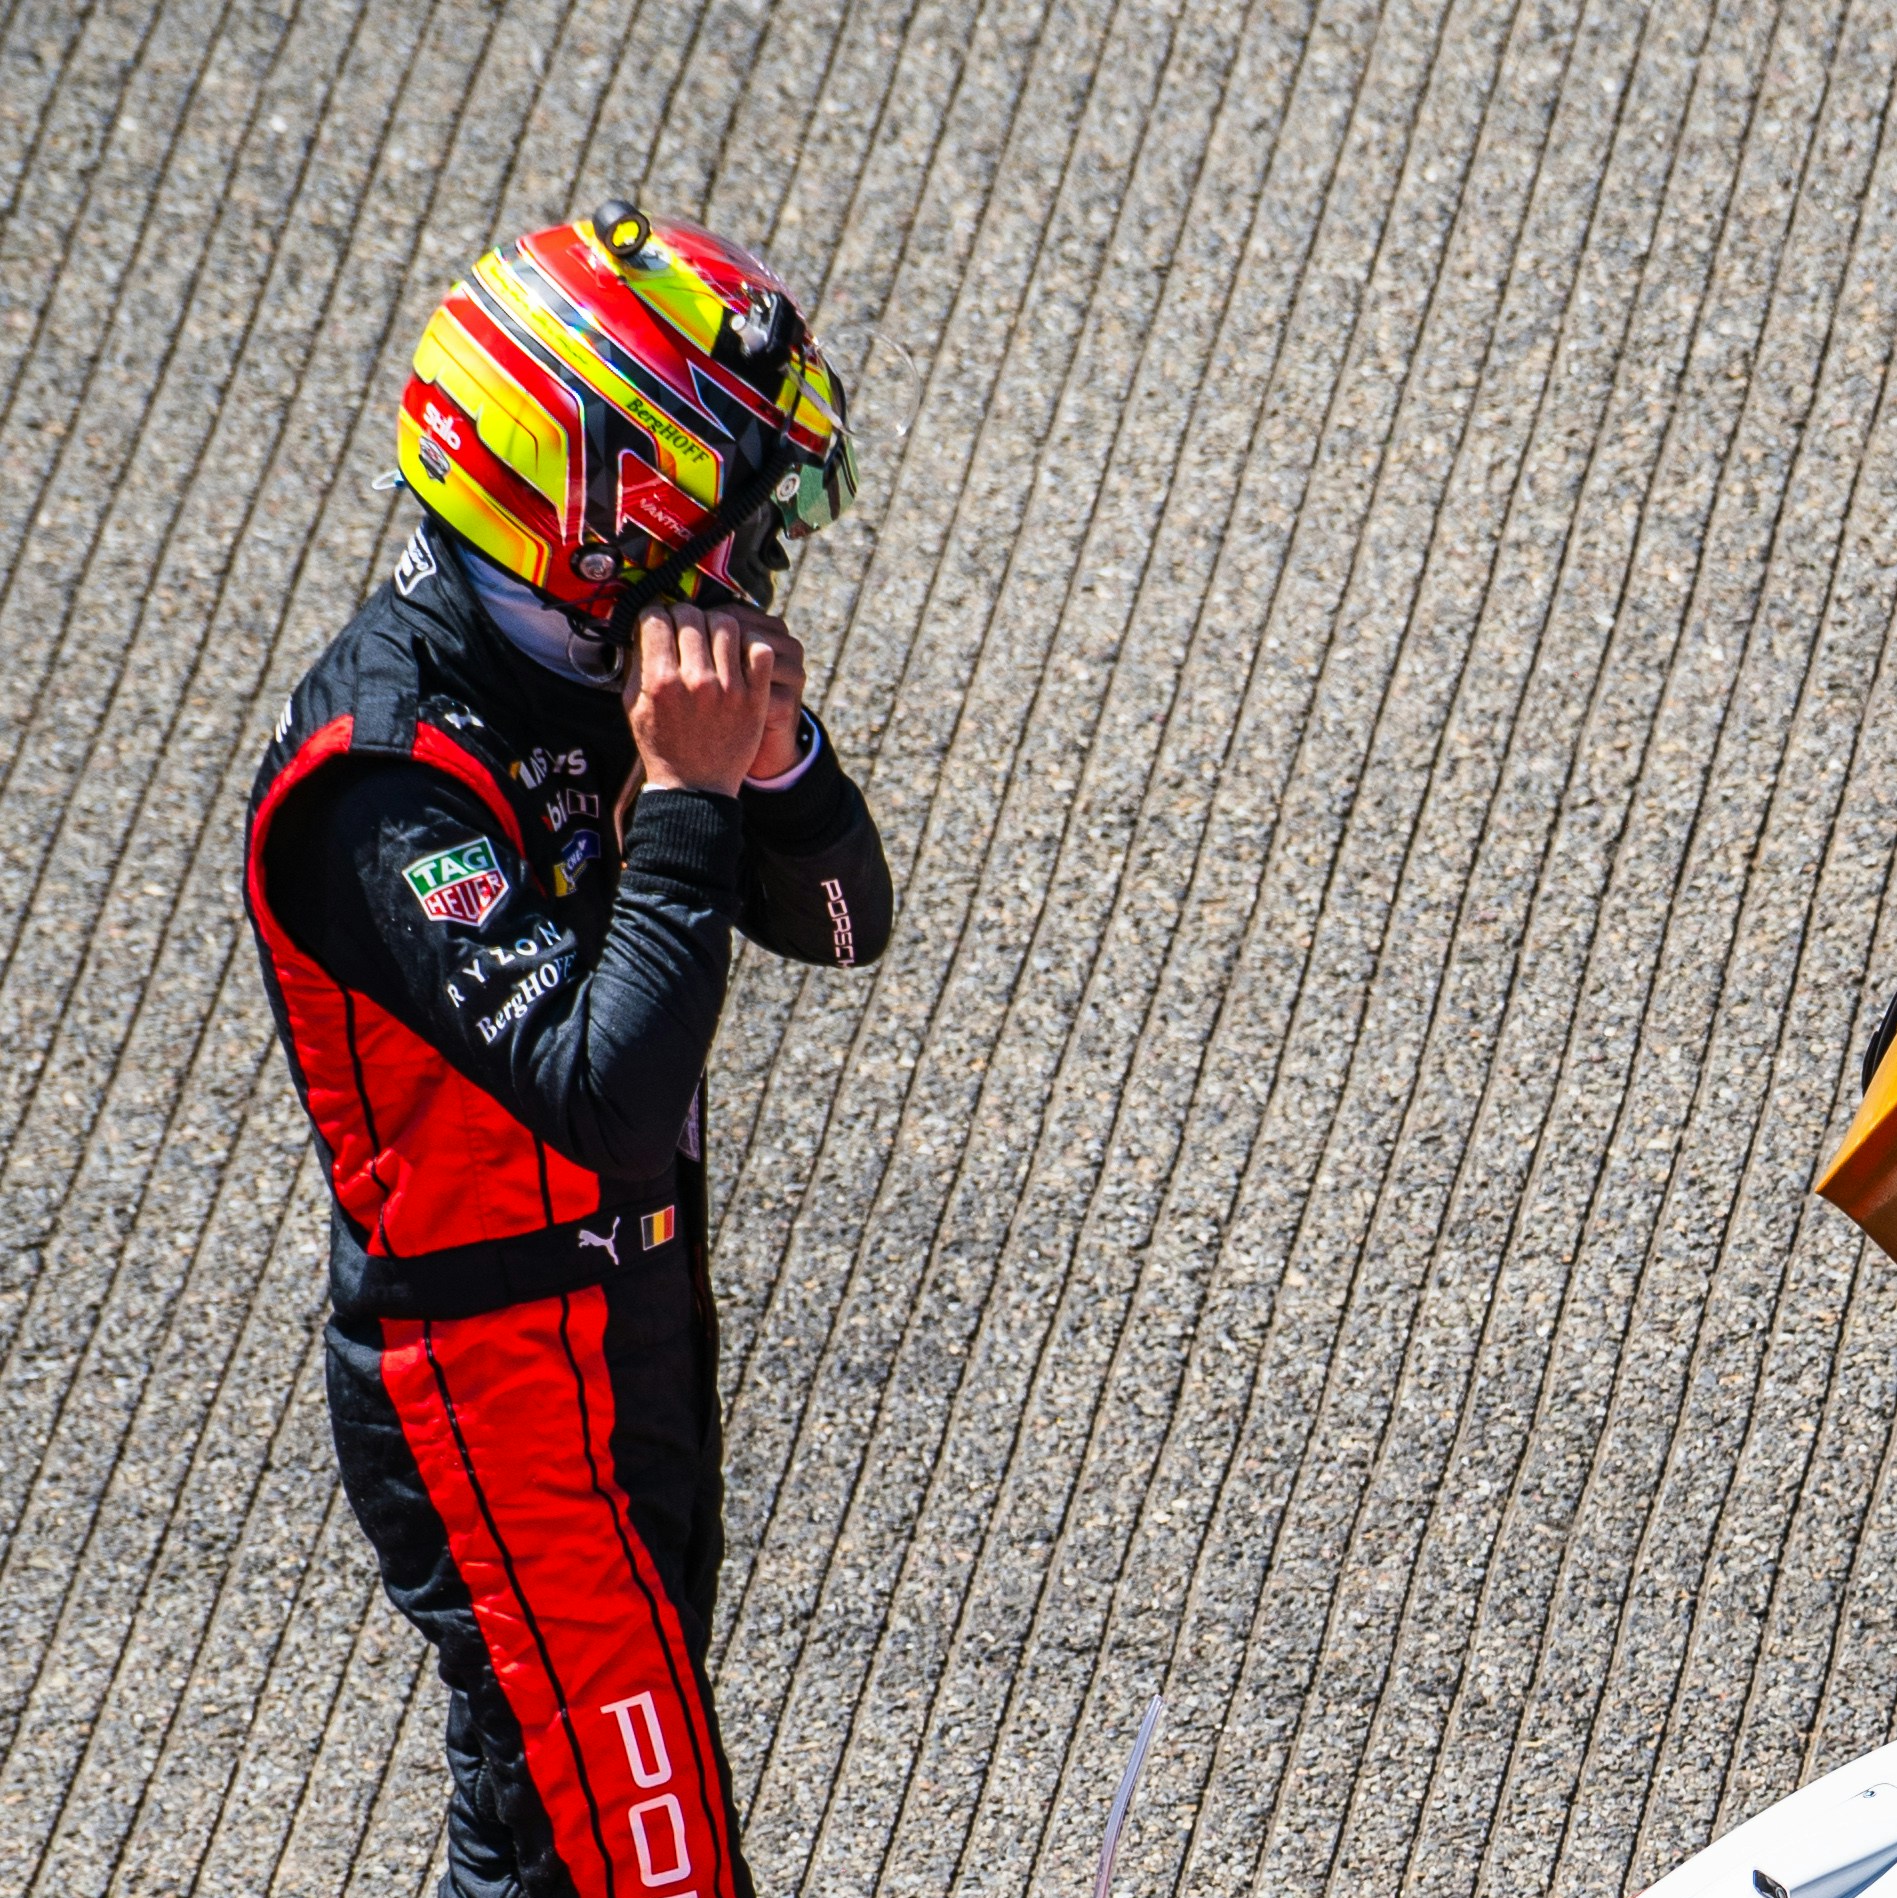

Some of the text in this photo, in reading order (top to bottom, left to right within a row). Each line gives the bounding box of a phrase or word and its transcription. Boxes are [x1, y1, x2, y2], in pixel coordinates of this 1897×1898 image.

[626, 398, 709, 464] BergHOFF
[413, 846, 489, 889] TAG
[424, 874, 503, 920] HEUER
